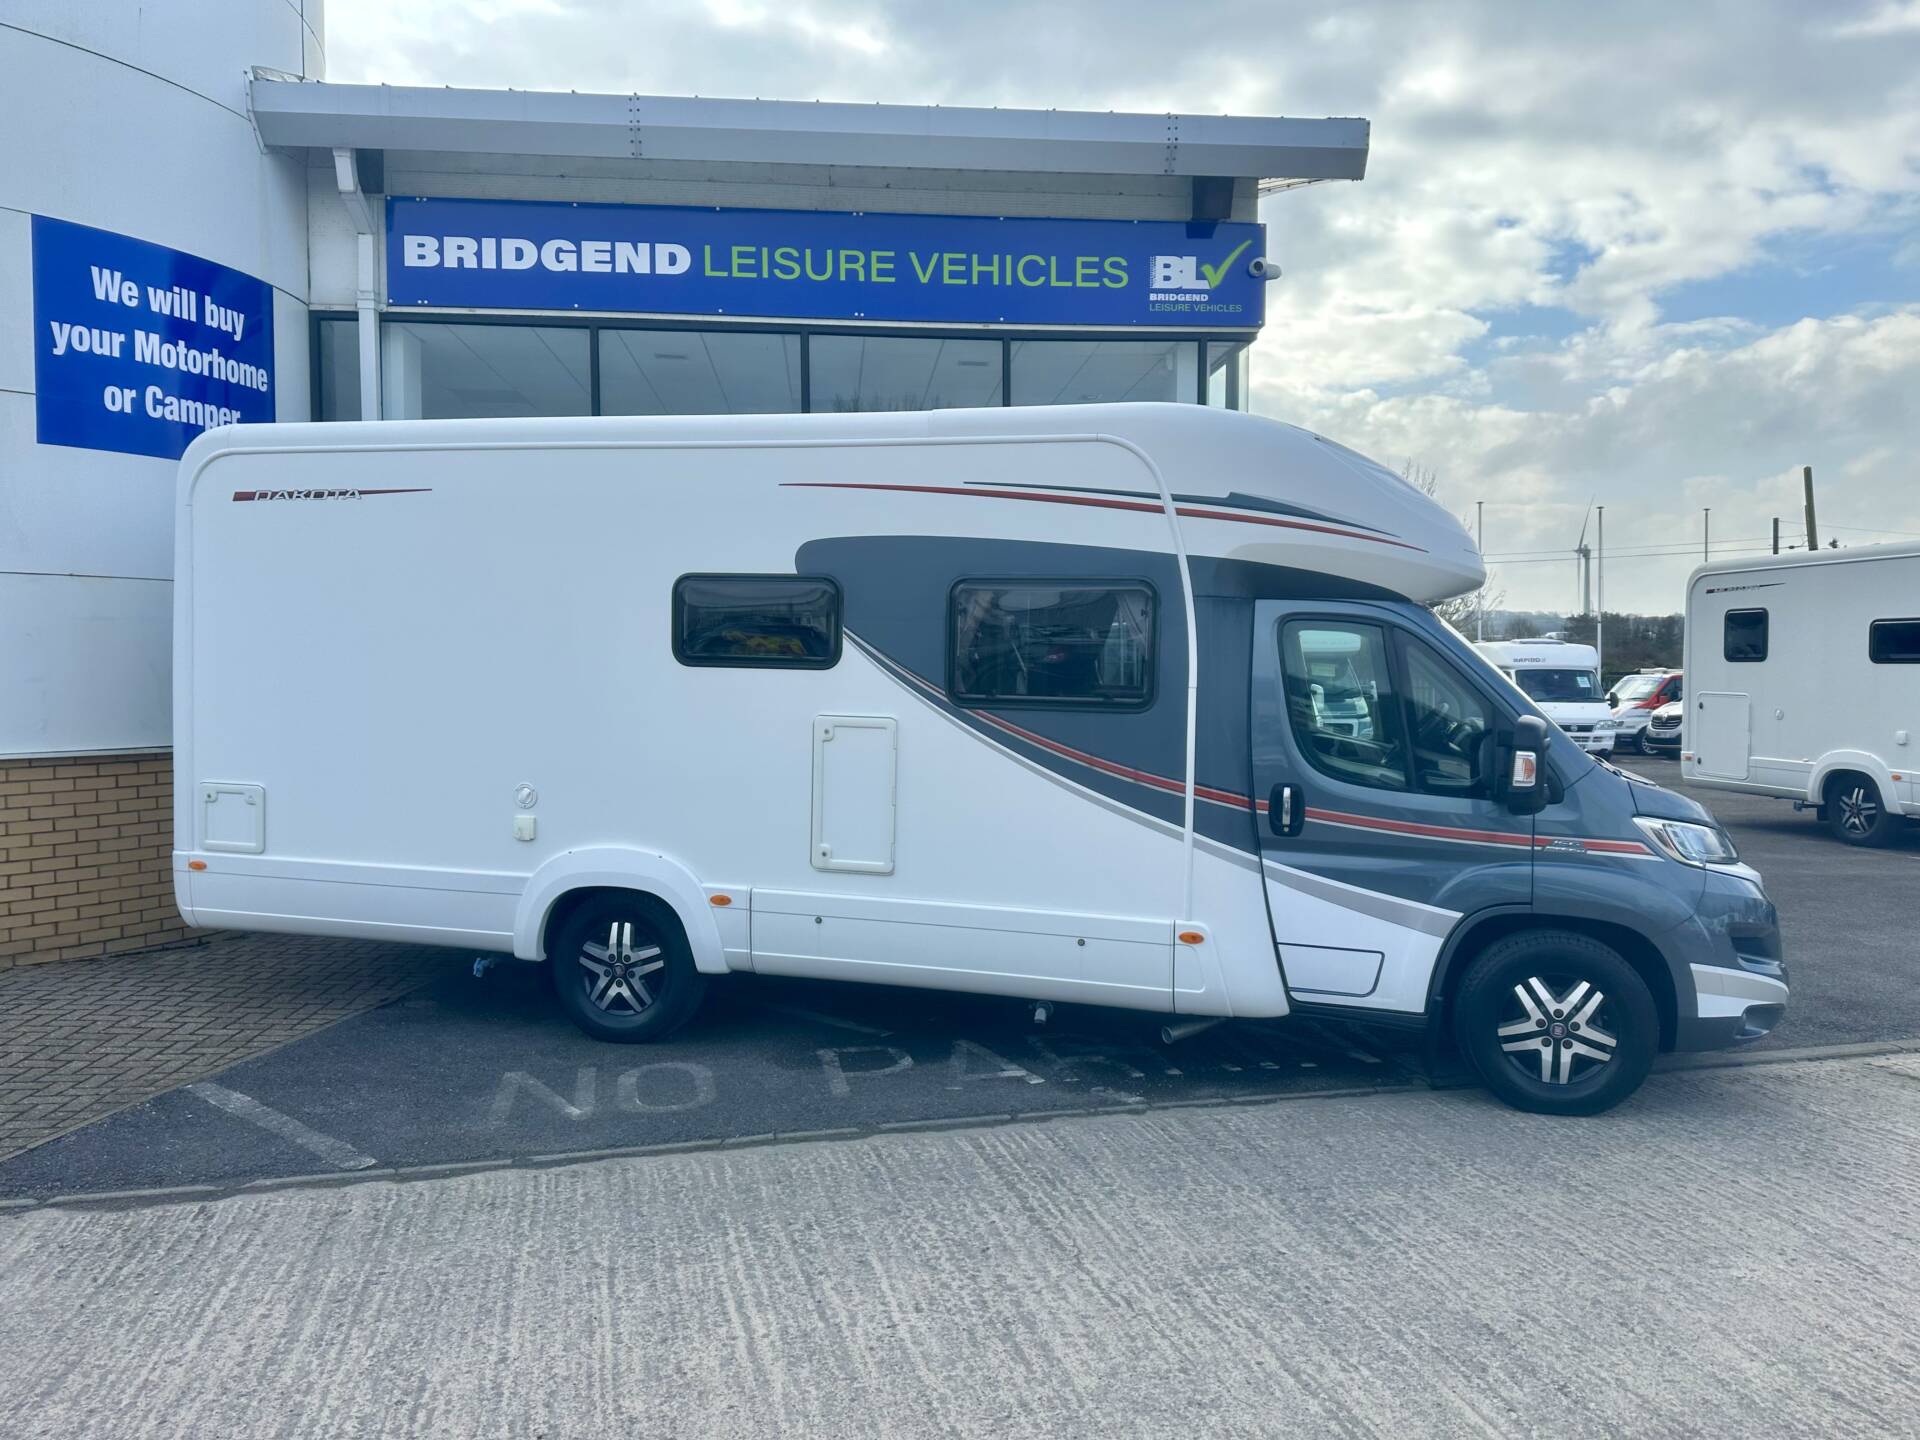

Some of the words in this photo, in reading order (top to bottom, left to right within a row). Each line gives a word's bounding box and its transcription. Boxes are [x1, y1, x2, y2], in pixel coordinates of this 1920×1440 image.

[403, 234, 692, 276] BRIDGEND
[703, 244, 896, 284] LEISURE
[908, 250, 1130, 290] VEHICLES
[91, 265, 138, 307] We
[147, 285, 197, 322] will
[204, 295, 245, 341] buy
[1149, 293, 1209, 302] BRIDGEND
[1149, 303, 1191, 312] LEISURE
[1194, 304, 1243, 313] VEHICLES
[50, 320, 125, 358] your
[134, 329, 269, 392] Motorhome
[103, 385, 136, 414] or
[145, 385, 241, 430] Camper
[254, 488, 362, 501] DAKOTA
[490, 1061, 718, 1130] NO
